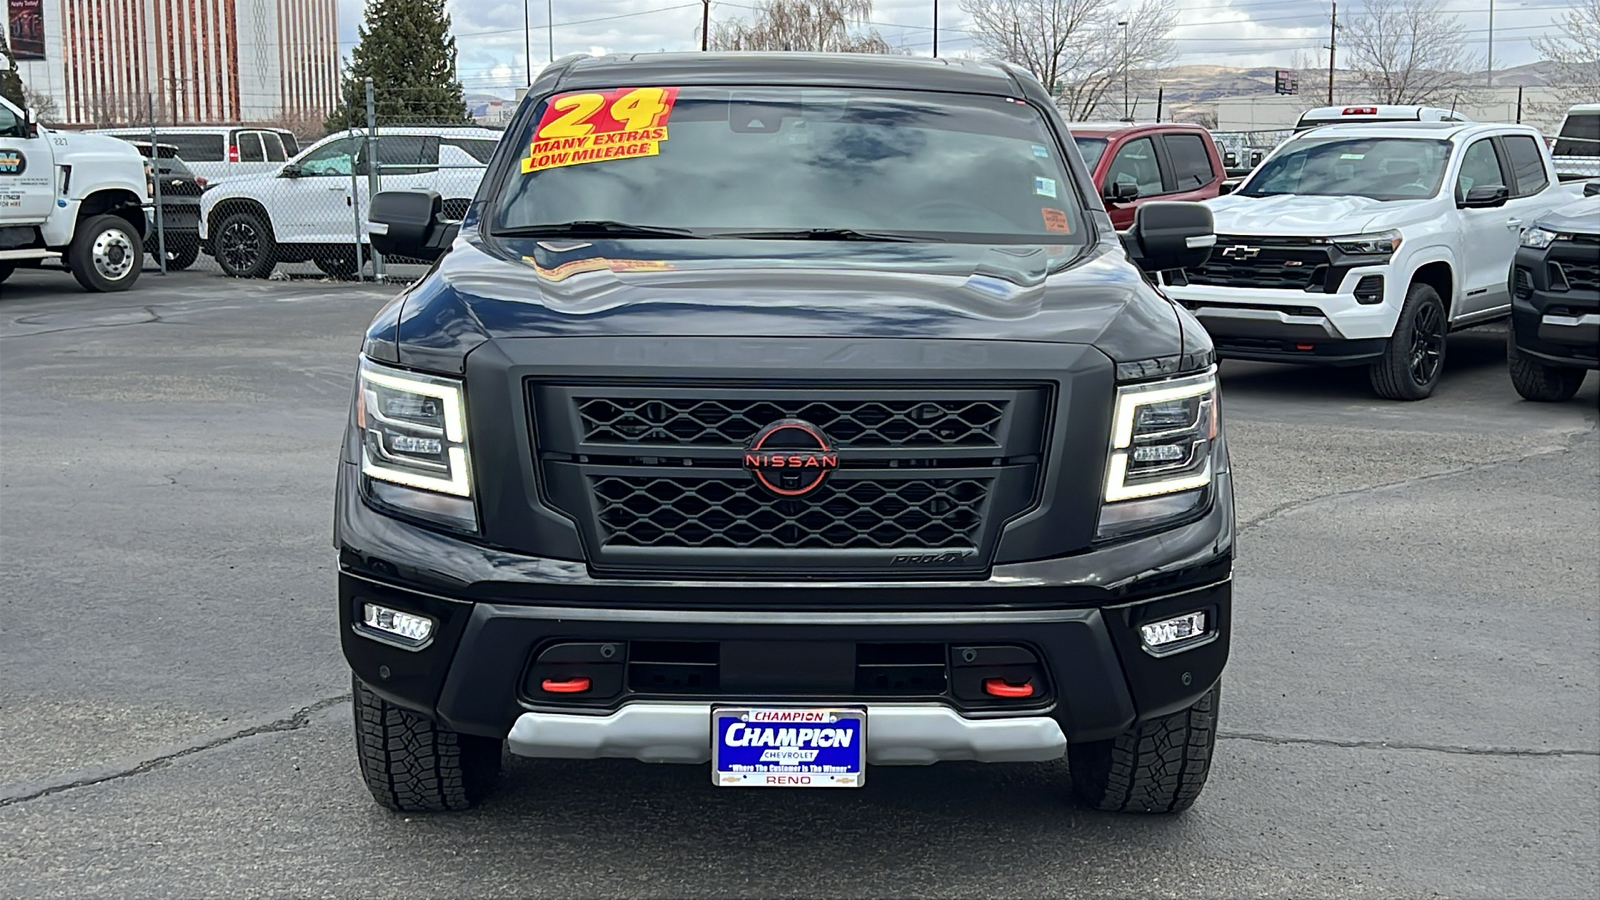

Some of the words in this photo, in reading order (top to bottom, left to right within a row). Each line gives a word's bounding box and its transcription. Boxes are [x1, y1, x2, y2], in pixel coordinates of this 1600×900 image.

[539, 87, 670, 138] 24
[53, 137, 68, 146] 227
[532, 137, 589, 155] MANY
[593, 128, 667, 146] EXTRAS
[529, 152, 571, 169] LOW
[571, 142, 652, 163] MILEAGE
[745, 453, 837, 468] NISSAN
[754, 711, 825, 722] CHAMPION
[724, 722, 853, 748] CHAMPION
[764, 751, 814, 759] CHEVROLET
[769, 764, 801, 772] Customer
[766, 775, 811, 785] RENO
